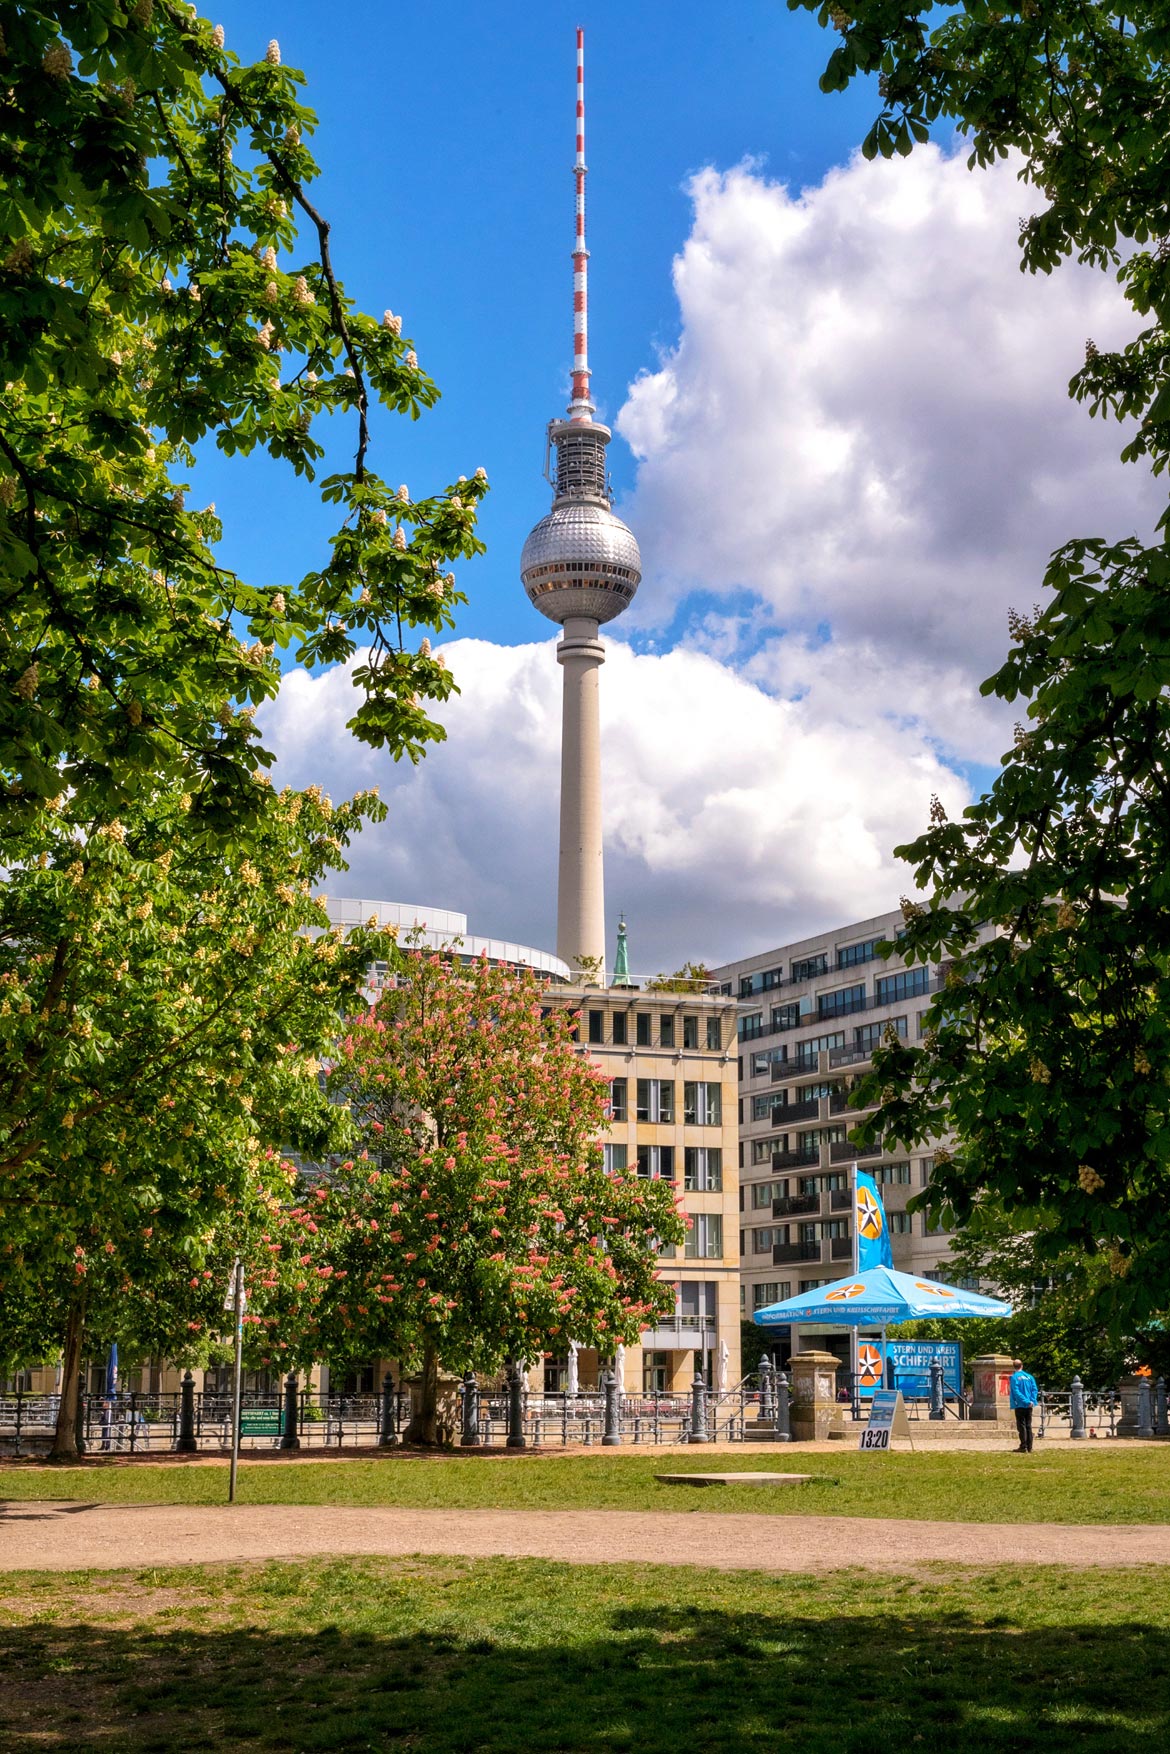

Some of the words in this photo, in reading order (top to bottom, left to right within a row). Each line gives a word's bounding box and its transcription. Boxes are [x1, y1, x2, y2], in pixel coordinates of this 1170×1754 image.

[812, 1307, 833, 1315] STERN
[893, 1345, 916, 1354] STERN
[917, 1345, 934, 1354] UND
[935, 1345, 956, 1355] KREIS
[860, 1430, 889, 1448] 13:20
